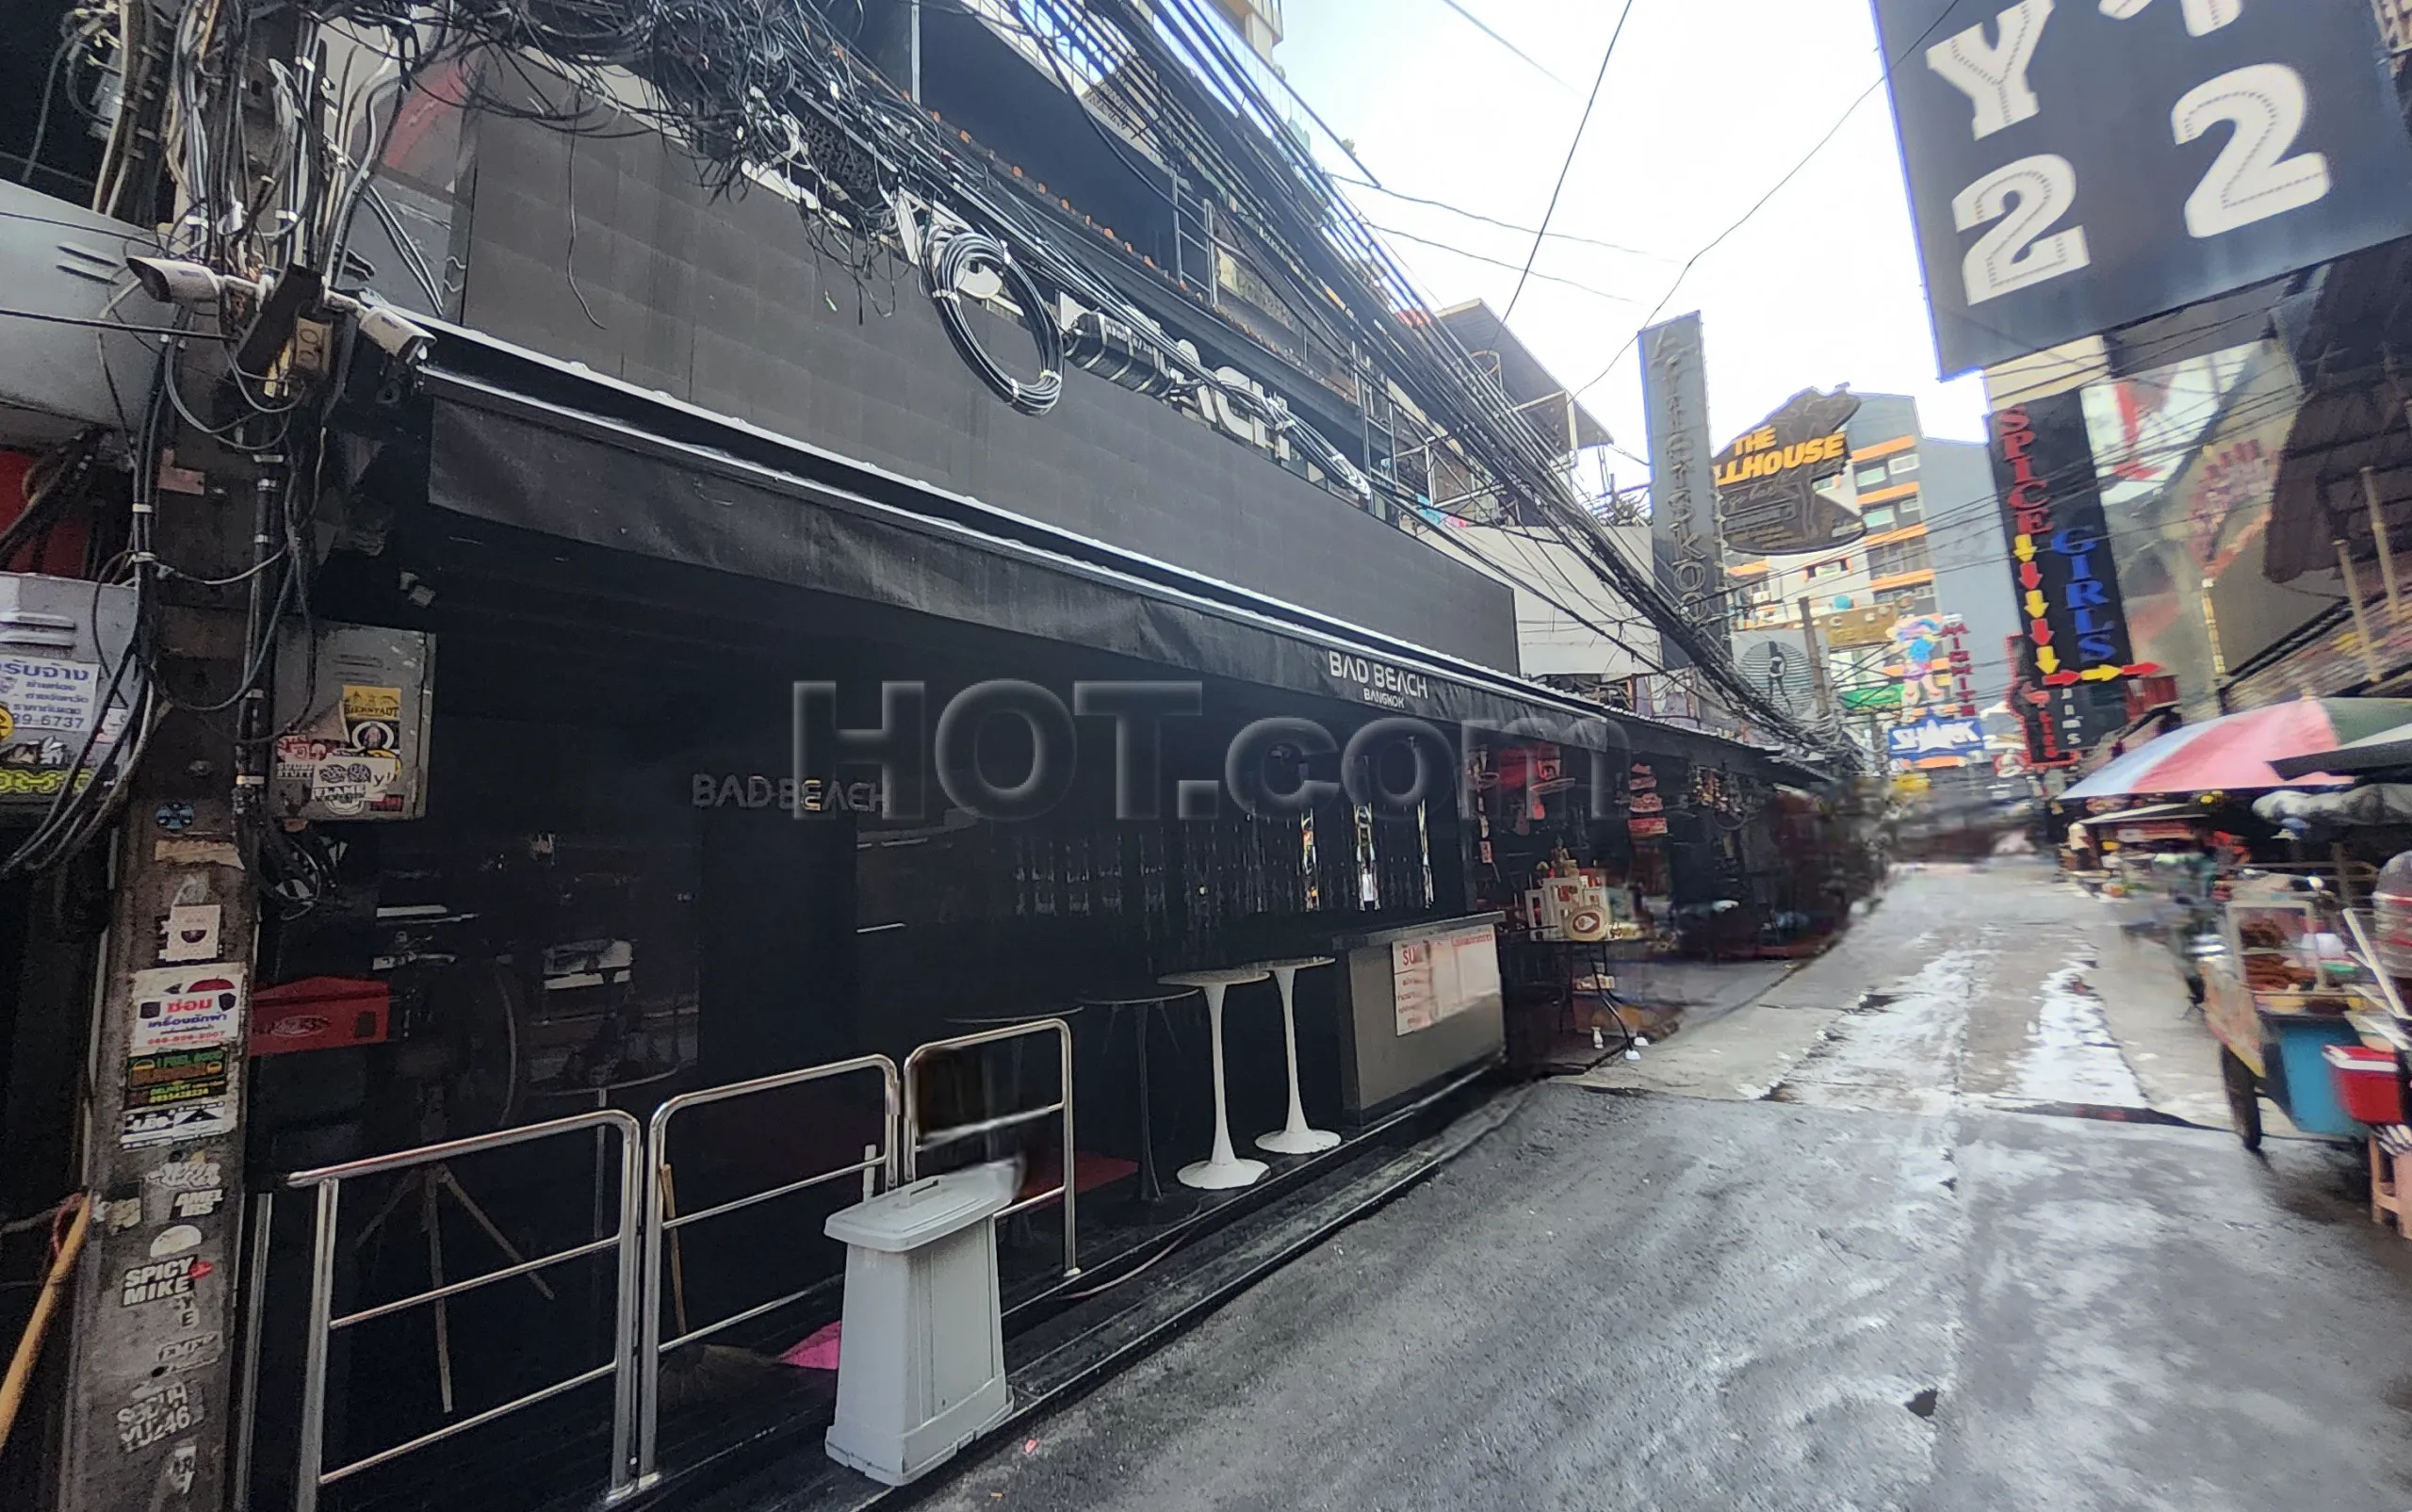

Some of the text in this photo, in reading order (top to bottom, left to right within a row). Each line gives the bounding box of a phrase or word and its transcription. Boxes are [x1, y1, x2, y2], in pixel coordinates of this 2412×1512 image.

[1733, 425, 1777, 457] THE
[1999, 405, 2055, 535] SPICE
[2050, 525, 2117, 663] GIRLS
[1328, 650, 1428, 699] BAD BEACH
[1363, 687, 1405, 708] BANGKOK
[691, 772, 888, 813] BAD BEACH
[124, 1256, 195, 1288] SPICY
[123, 1276, 191, 1307] MIKE
